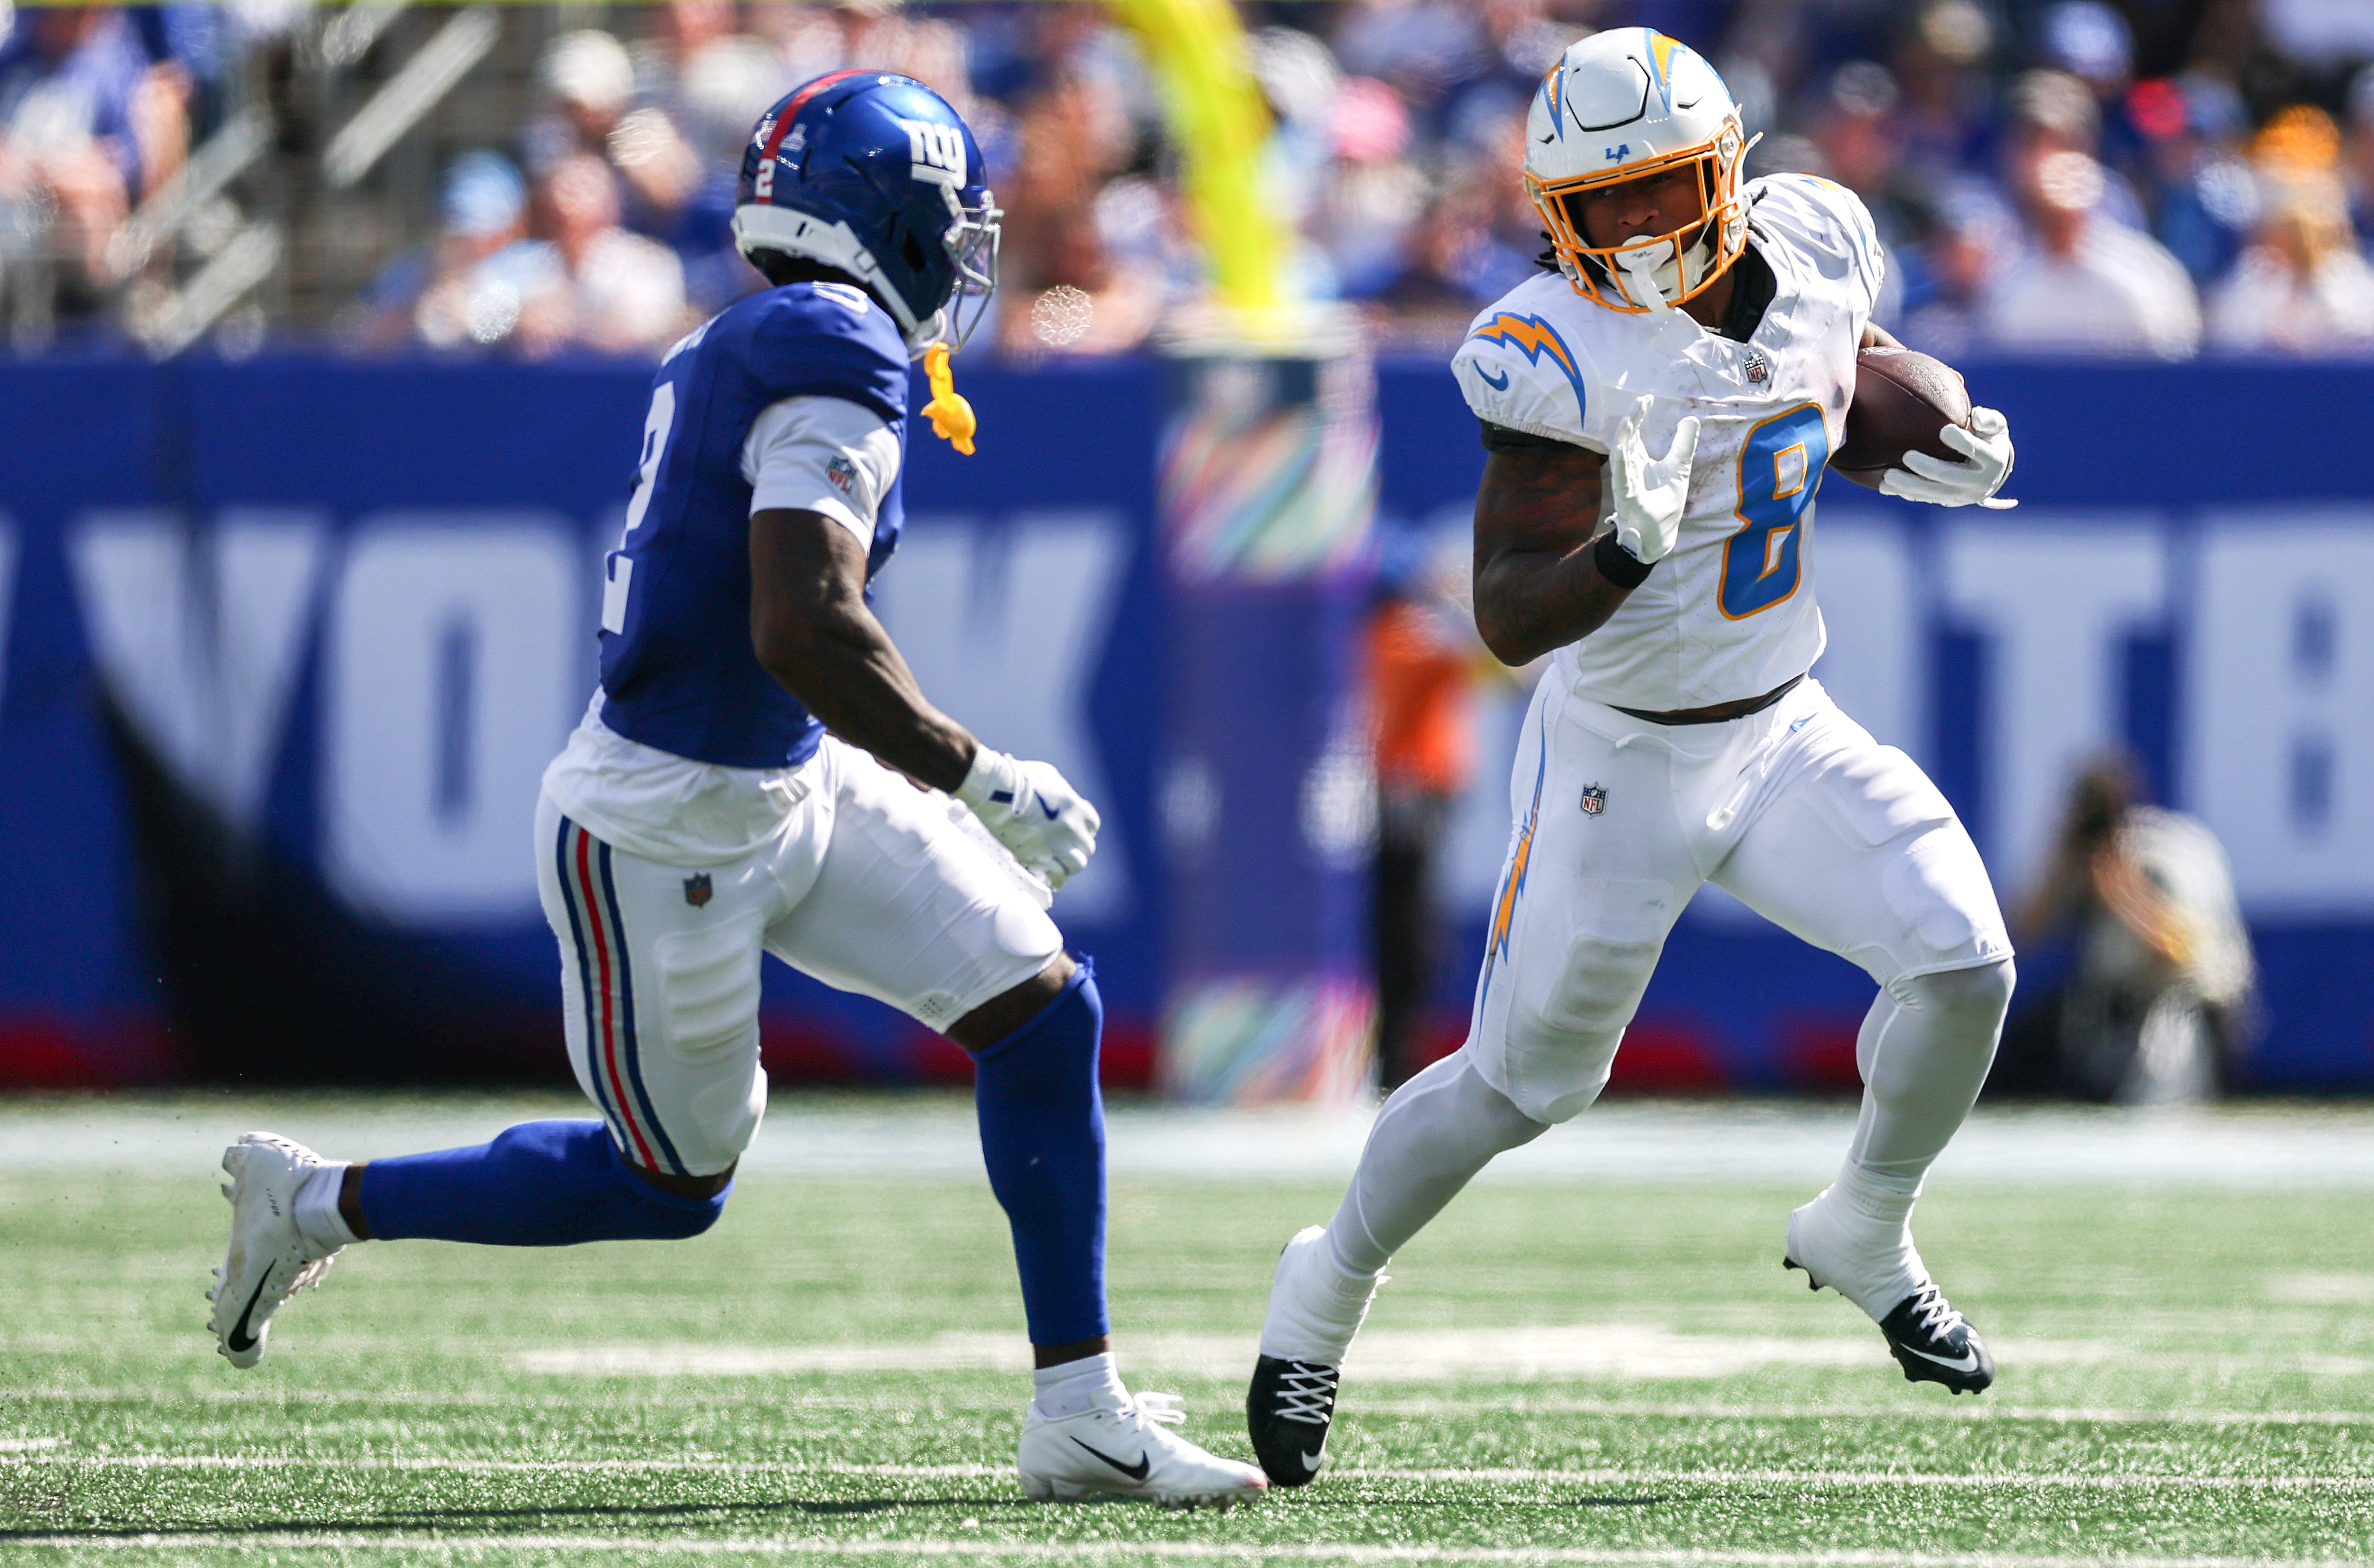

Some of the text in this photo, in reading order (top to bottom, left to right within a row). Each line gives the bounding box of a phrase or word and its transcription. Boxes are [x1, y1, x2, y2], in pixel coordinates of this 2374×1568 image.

[1606, 144, 1630, 164] LA
[755, 158, 776, 197] 2
[1749, 366, 1766, 380] NFL
[1717, 401, 1831, 621] 8
[1584, 797, 1602, 811] NFL
